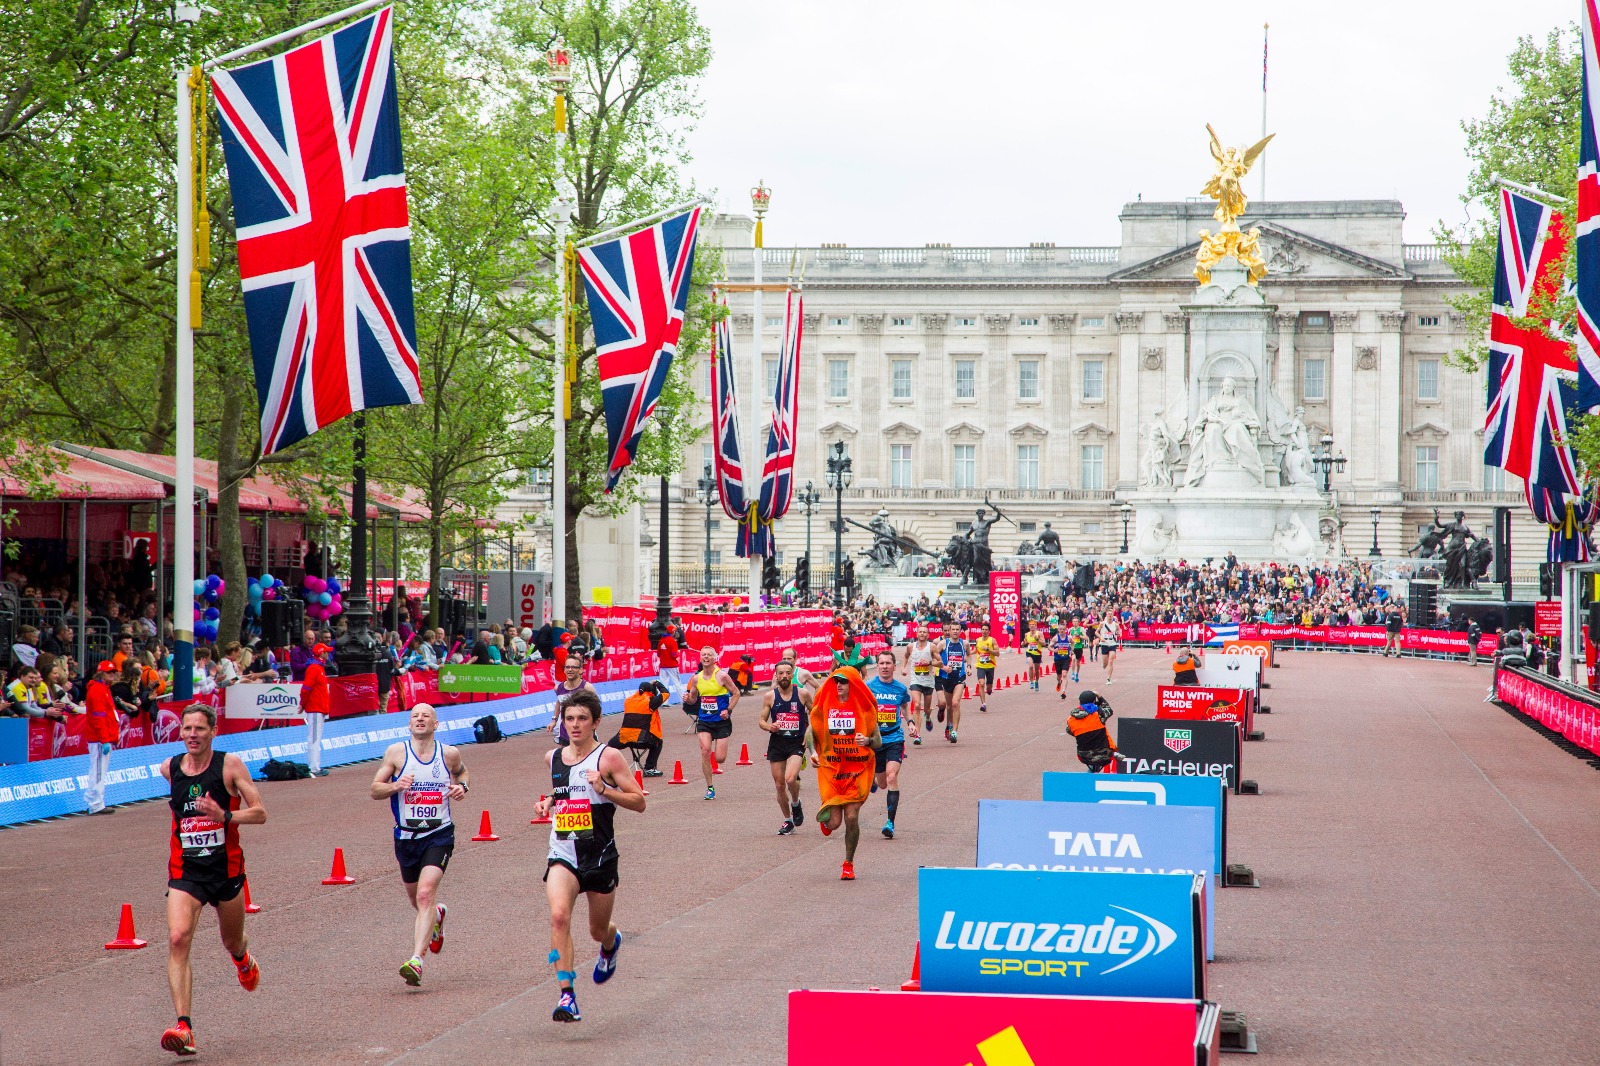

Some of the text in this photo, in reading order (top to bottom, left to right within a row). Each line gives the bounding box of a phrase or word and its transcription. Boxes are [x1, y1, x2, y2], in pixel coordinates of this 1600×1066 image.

[993, 593, 1018, 604] 200
[257, 694, 298, 706] Buxton
[876, 693, 897, 701] MARK
[1162, 690, 1214, 701] RUN WITH
[1162, 700, 1193, 709] PRIDE
[832, 719, 852, 728] 1410
[1166, 730, 1189, 739] TAG
[1166, 739, 1190, 751] HEUER
[13, 780, 52, 801] CONSULTANCY
[51, 777, 75, 797] SERVICES
[410, 806, 437, 818] 1690
[556, 814, 590, 829] 31848
[187, 832, 218, 846] 1671
[1048, 831, 1143, 858] TATA
[935, 911, 1139, 955] Lucozade
[979, 958, 1089, 978] SPORT
